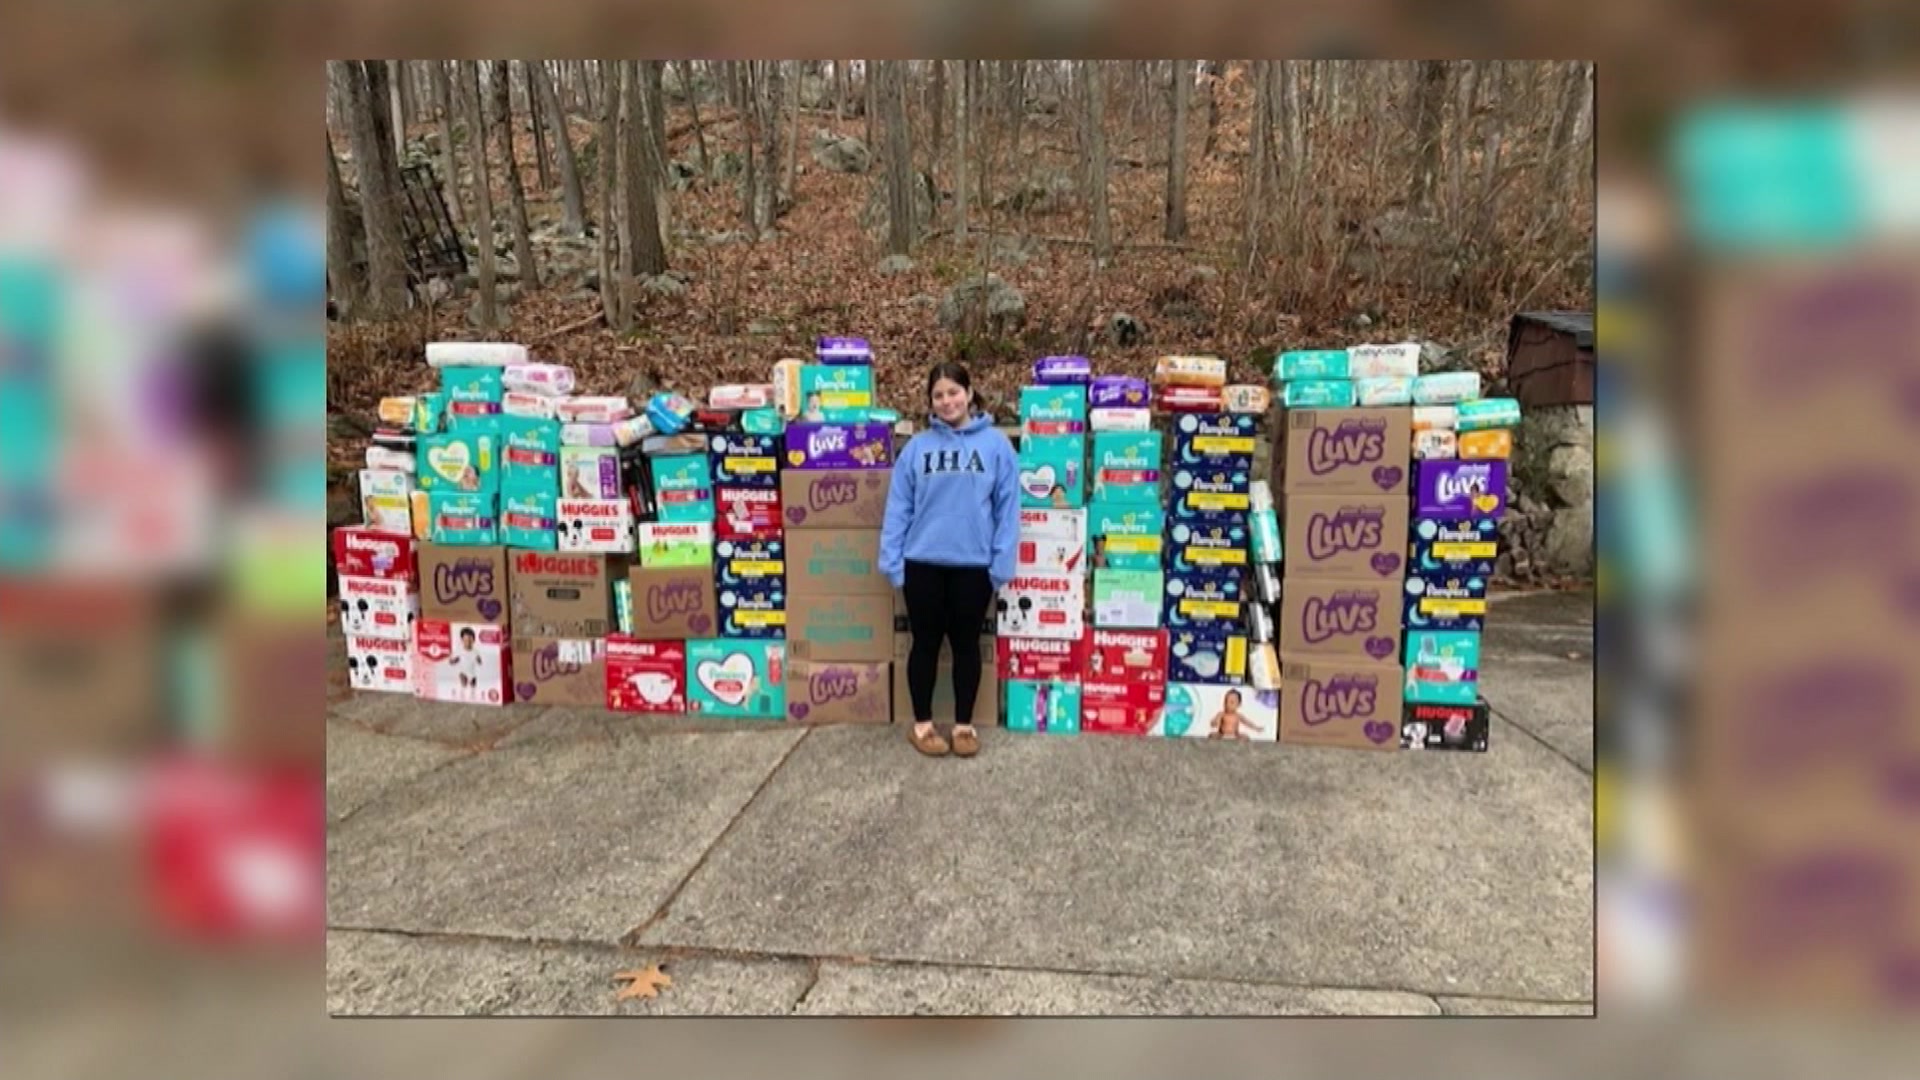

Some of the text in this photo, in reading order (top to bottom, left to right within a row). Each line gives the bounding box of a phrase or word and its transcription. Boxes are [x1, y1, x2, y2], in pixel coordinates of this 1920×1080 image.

[923, 448, 985, 475] IHA
[721, 488, 778, 502] HUGGIES
[561, 503, 619, 516] HUGGIES
[515, 552, 599, 576] HUGGIES
[347, 579, 397, 596] HUGGIES
[1009, 637, 1071, 655] HUGGIES
[1093, 632, 1158, 648] HUGGIES
